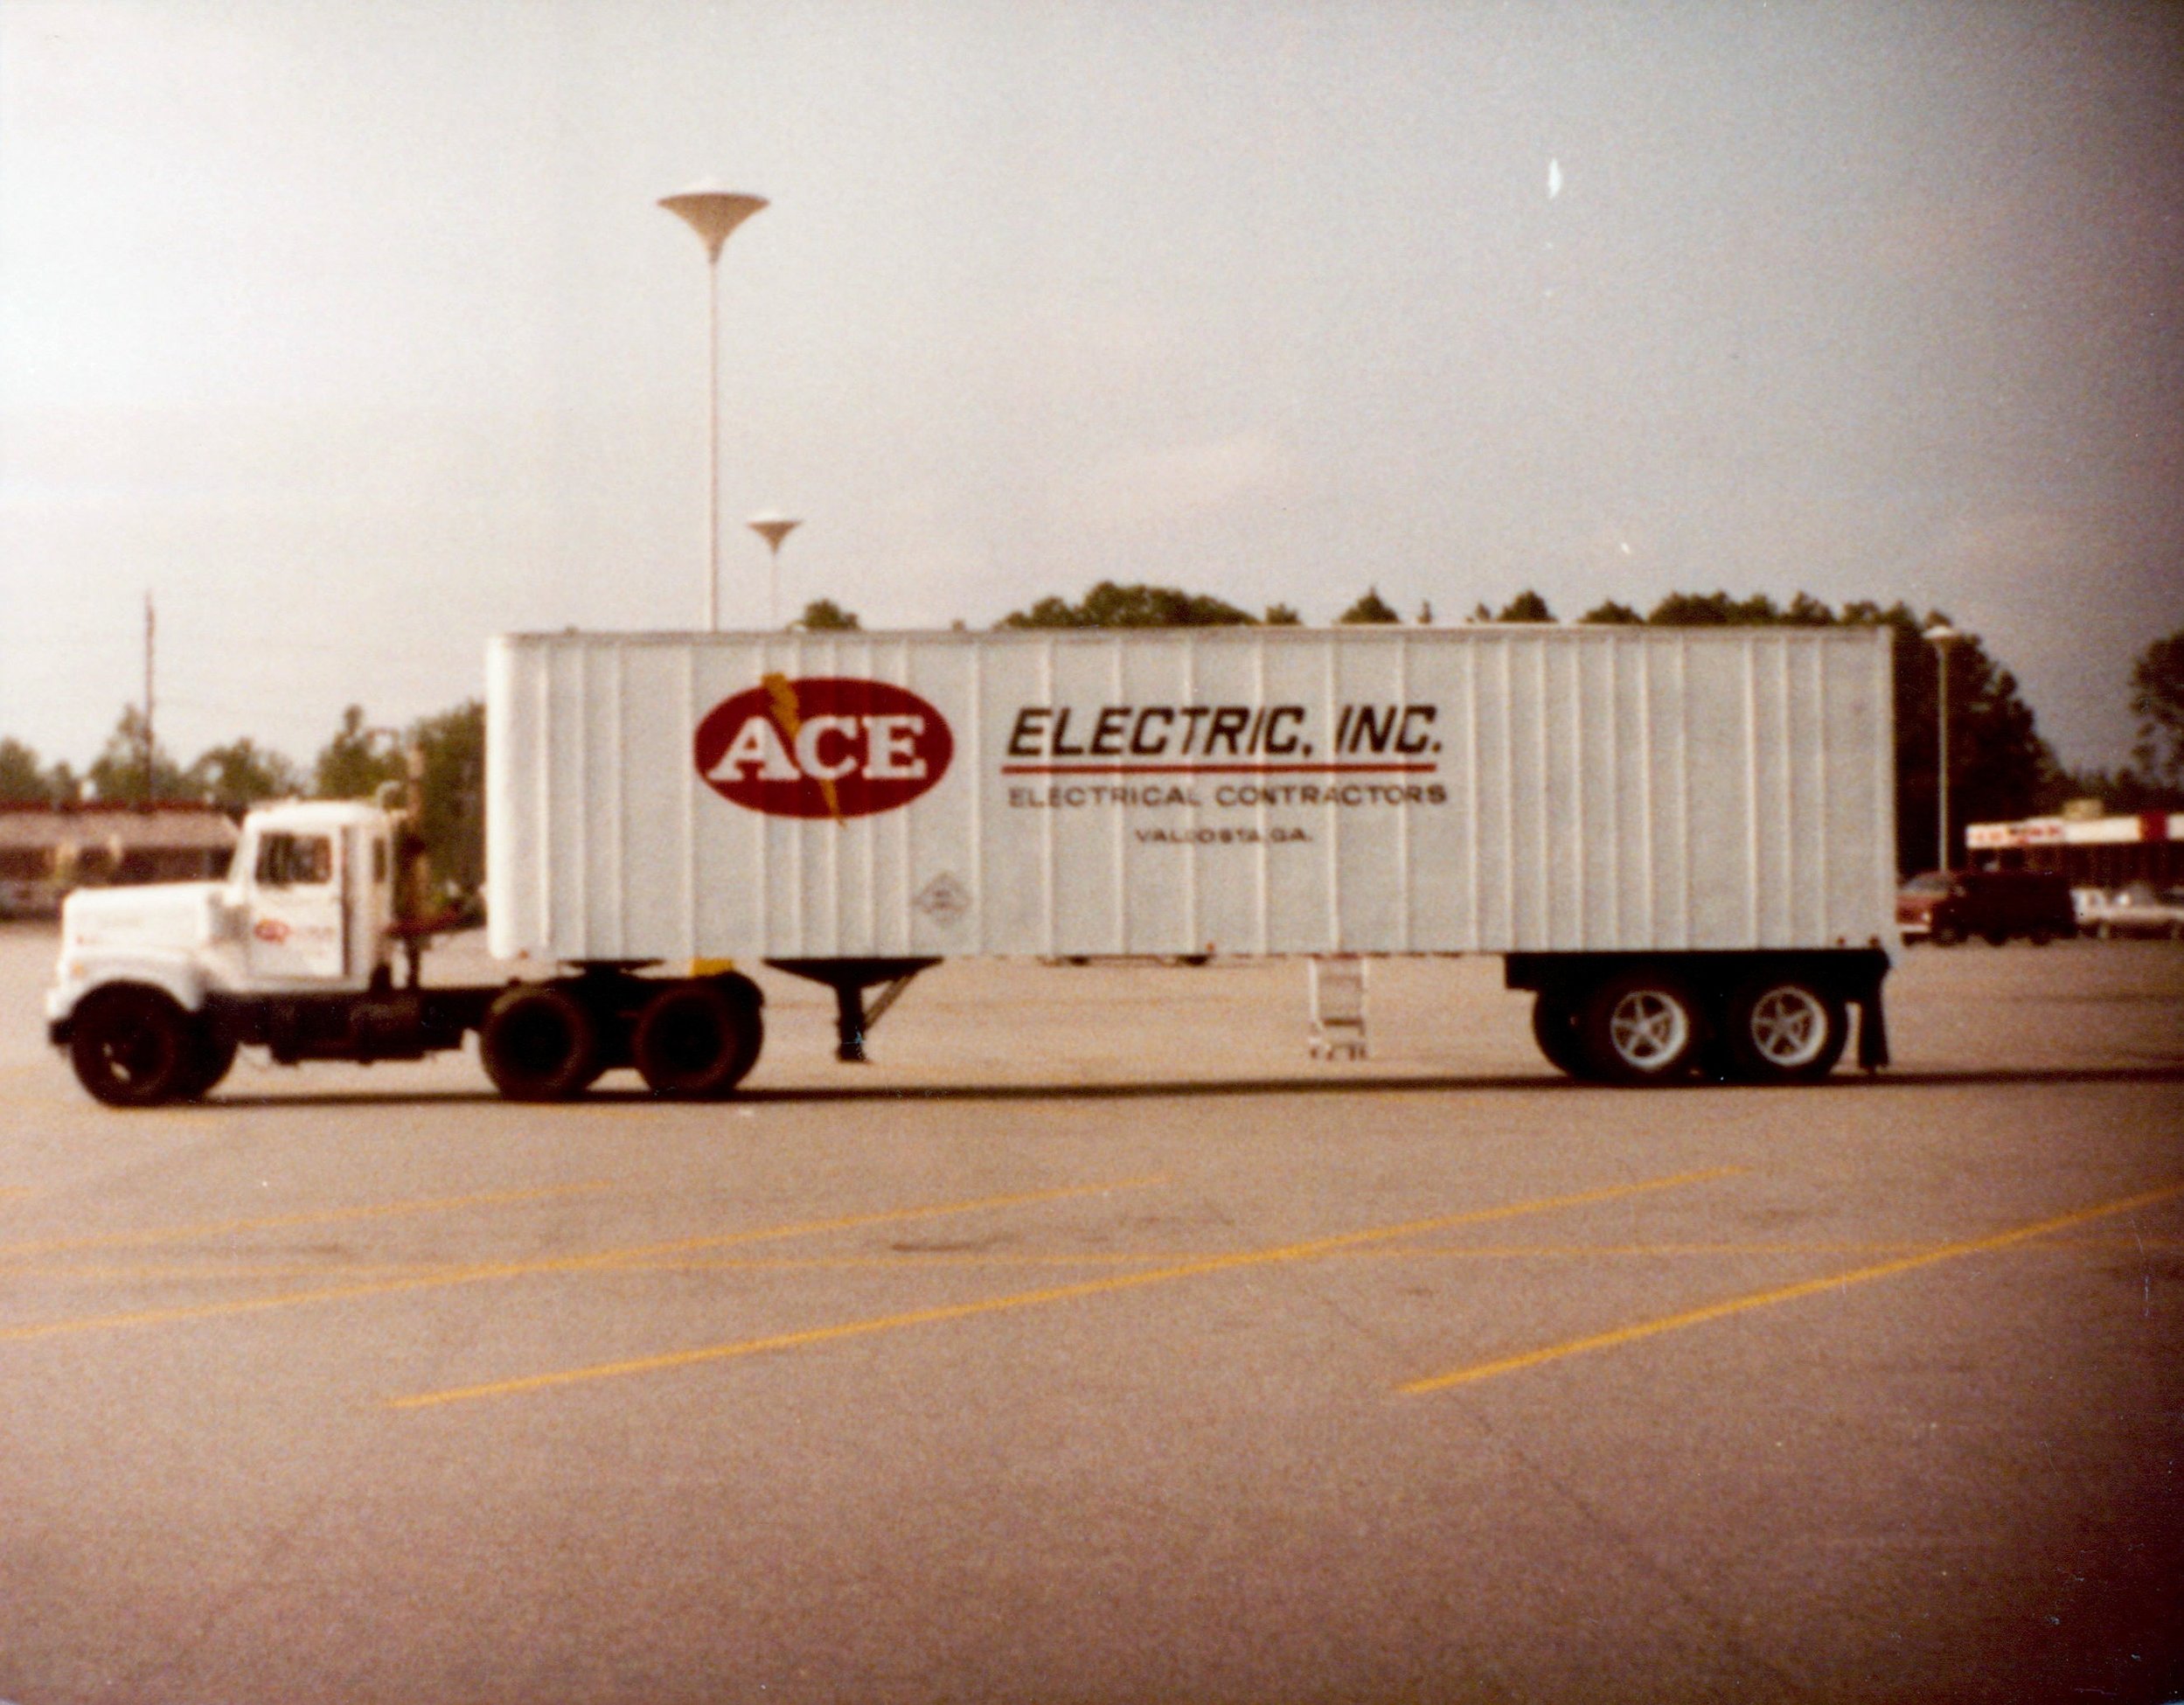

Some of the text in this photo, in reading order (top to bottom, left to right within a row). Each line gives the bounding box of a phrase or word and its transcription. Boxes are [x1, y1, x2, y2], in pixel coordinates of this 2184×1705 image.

[707, 715, 927, 781] ACE
[1334, 705, 1442, 755] INC.
[1008, 783, 1447, 808] ELECTRICAL CONTRACTORS
